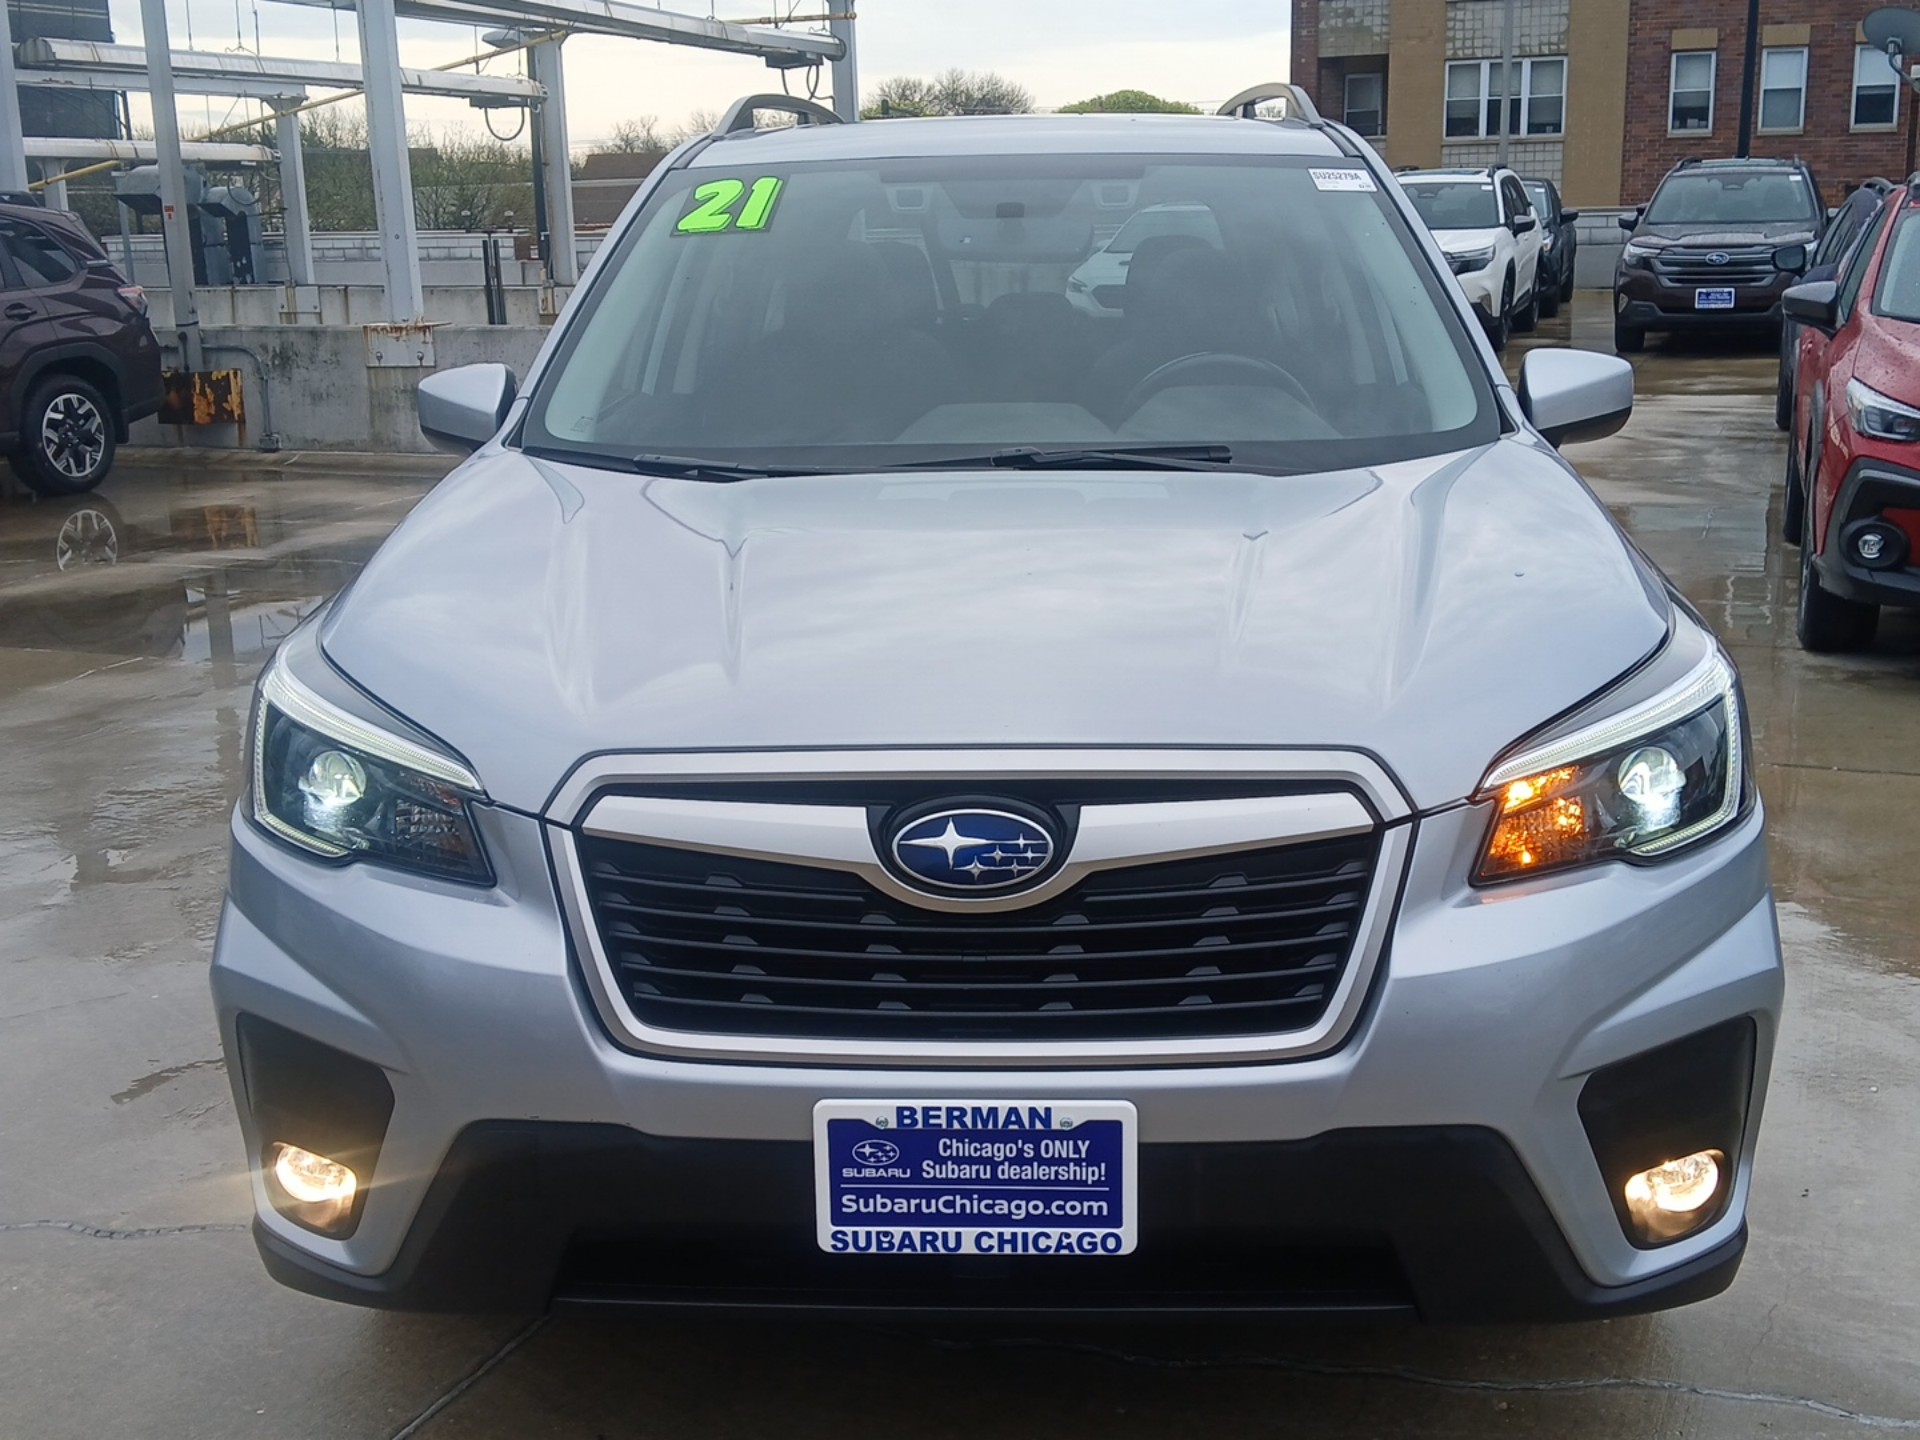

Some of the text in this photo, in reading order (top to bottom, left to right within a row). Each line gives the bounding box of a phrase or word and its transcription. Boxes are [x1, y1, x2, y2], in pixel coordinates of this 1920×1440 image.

[677, 176, 783, 233] 21
[896, 1106, 1053, 1129] BERMAN
[938, 1138, 1090, 1161] Chicago's ONLY
[842, 1167, 911, 1178] SUBARU
[921, 1160, 1107, 1184] Subaru dealership!
[841, 1194, 1109, 1220] SubaruChicago.com
[830, 1230, 1123, 1254] SUBARU CHICAGO
